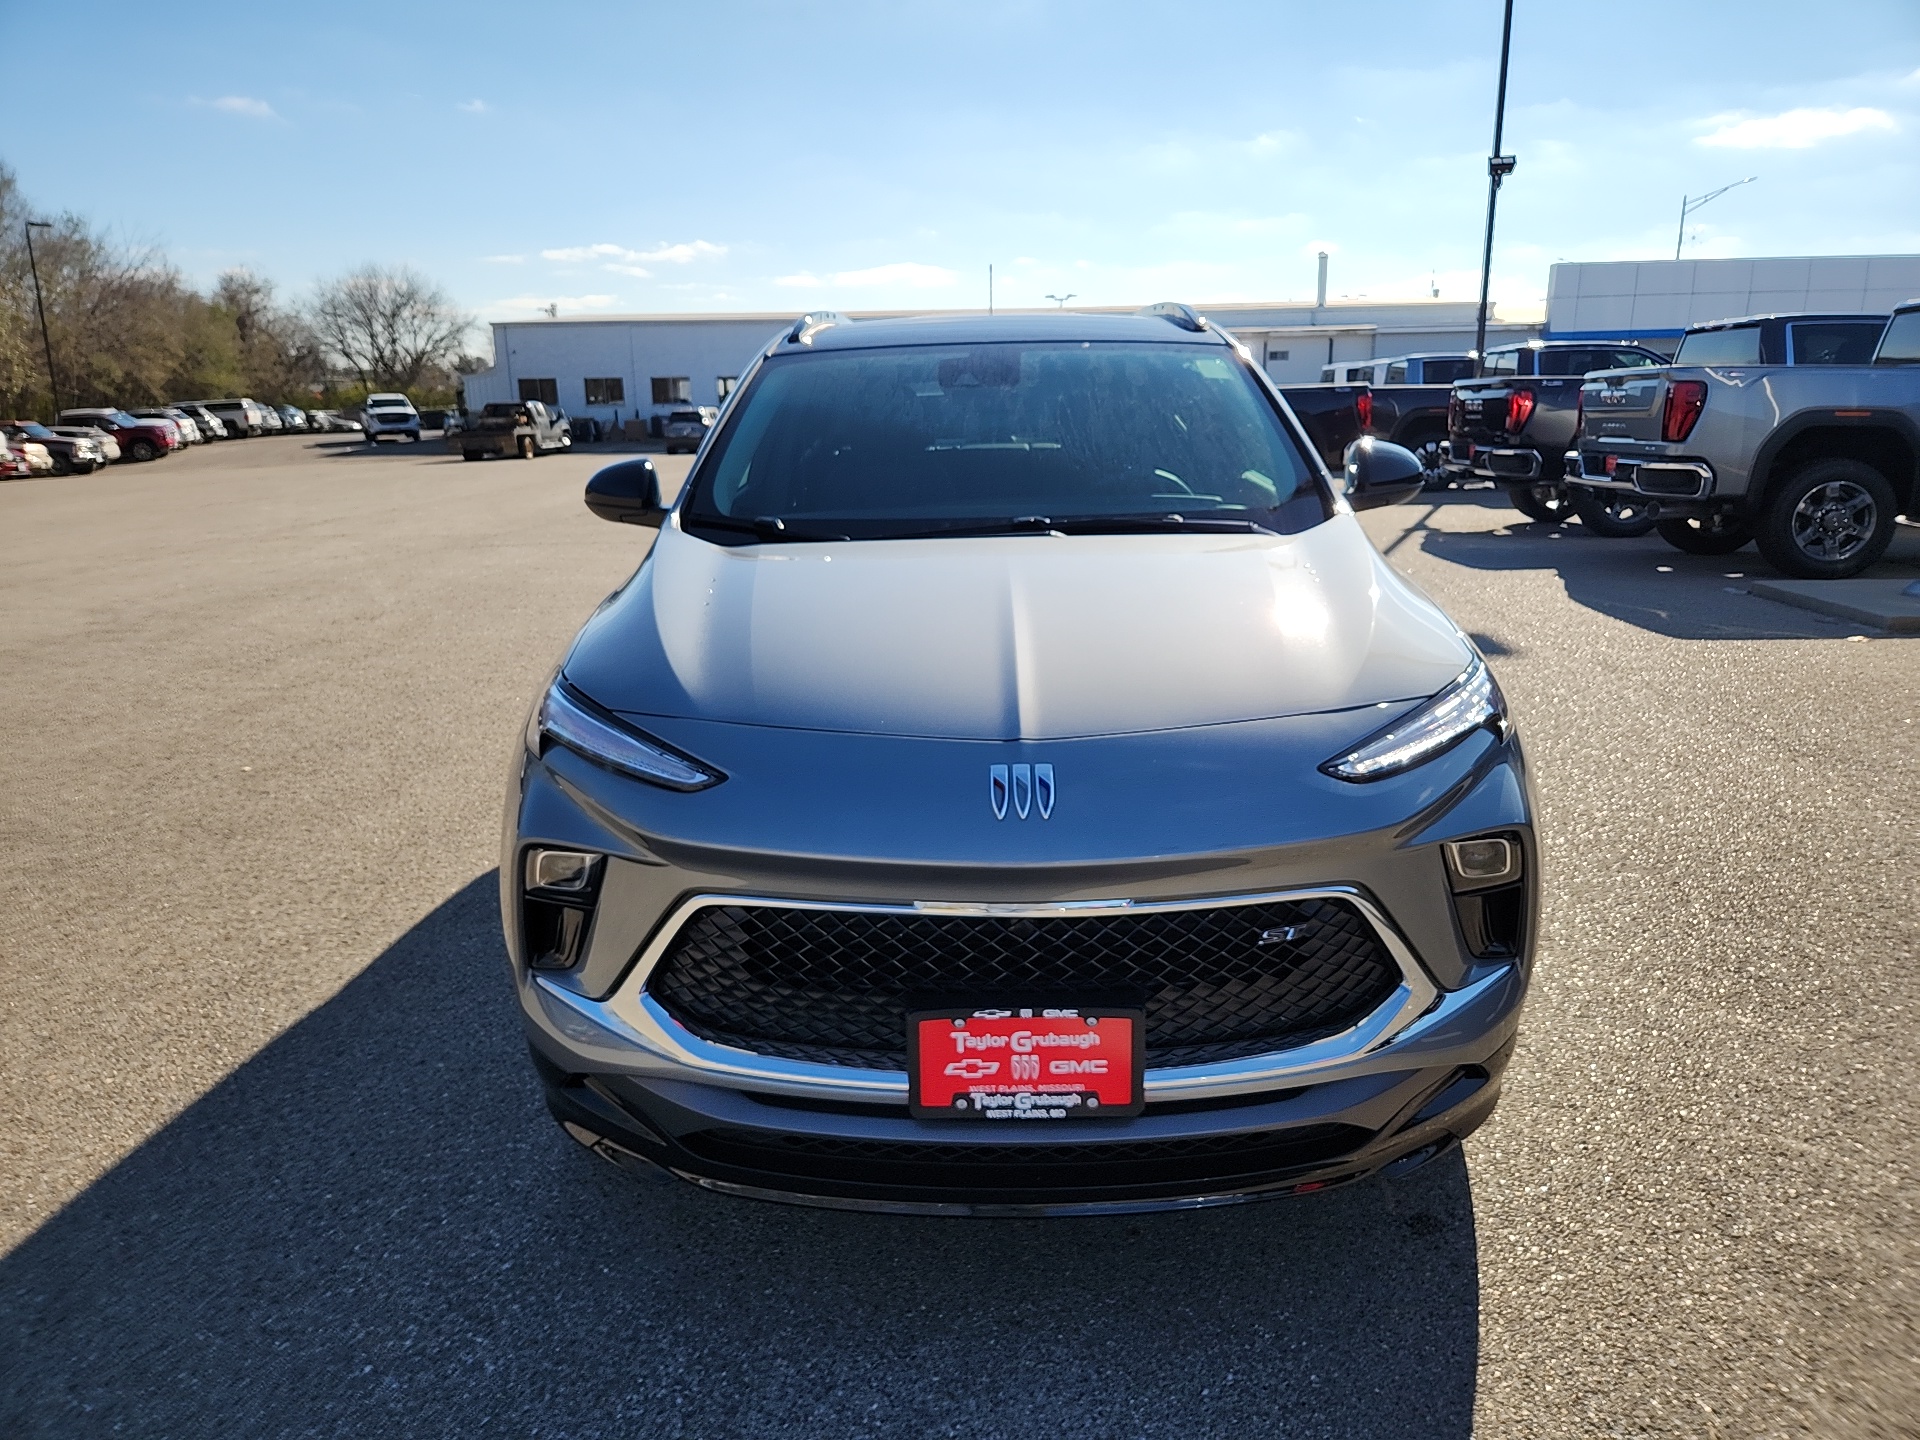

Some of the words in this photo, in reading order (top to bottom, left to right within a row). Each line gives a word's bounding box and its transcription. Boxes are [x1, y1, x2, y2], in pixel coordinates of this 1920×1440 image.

[1042, 1008, 1079, 1018] GMC
[950, 1031, 1009, 1054] Taylor
[1010, 1031, 1101, 1053] Grubaugh
[1049, 1060, 1109, 1074] GMC
[968, 1084, 996, 1092] WEST
[969, 1092, 1014, 1110] Taylor
[1014, 1092, 1082, 1110] Grubaugh
[985, 1109, 1013, 1119] WEST
